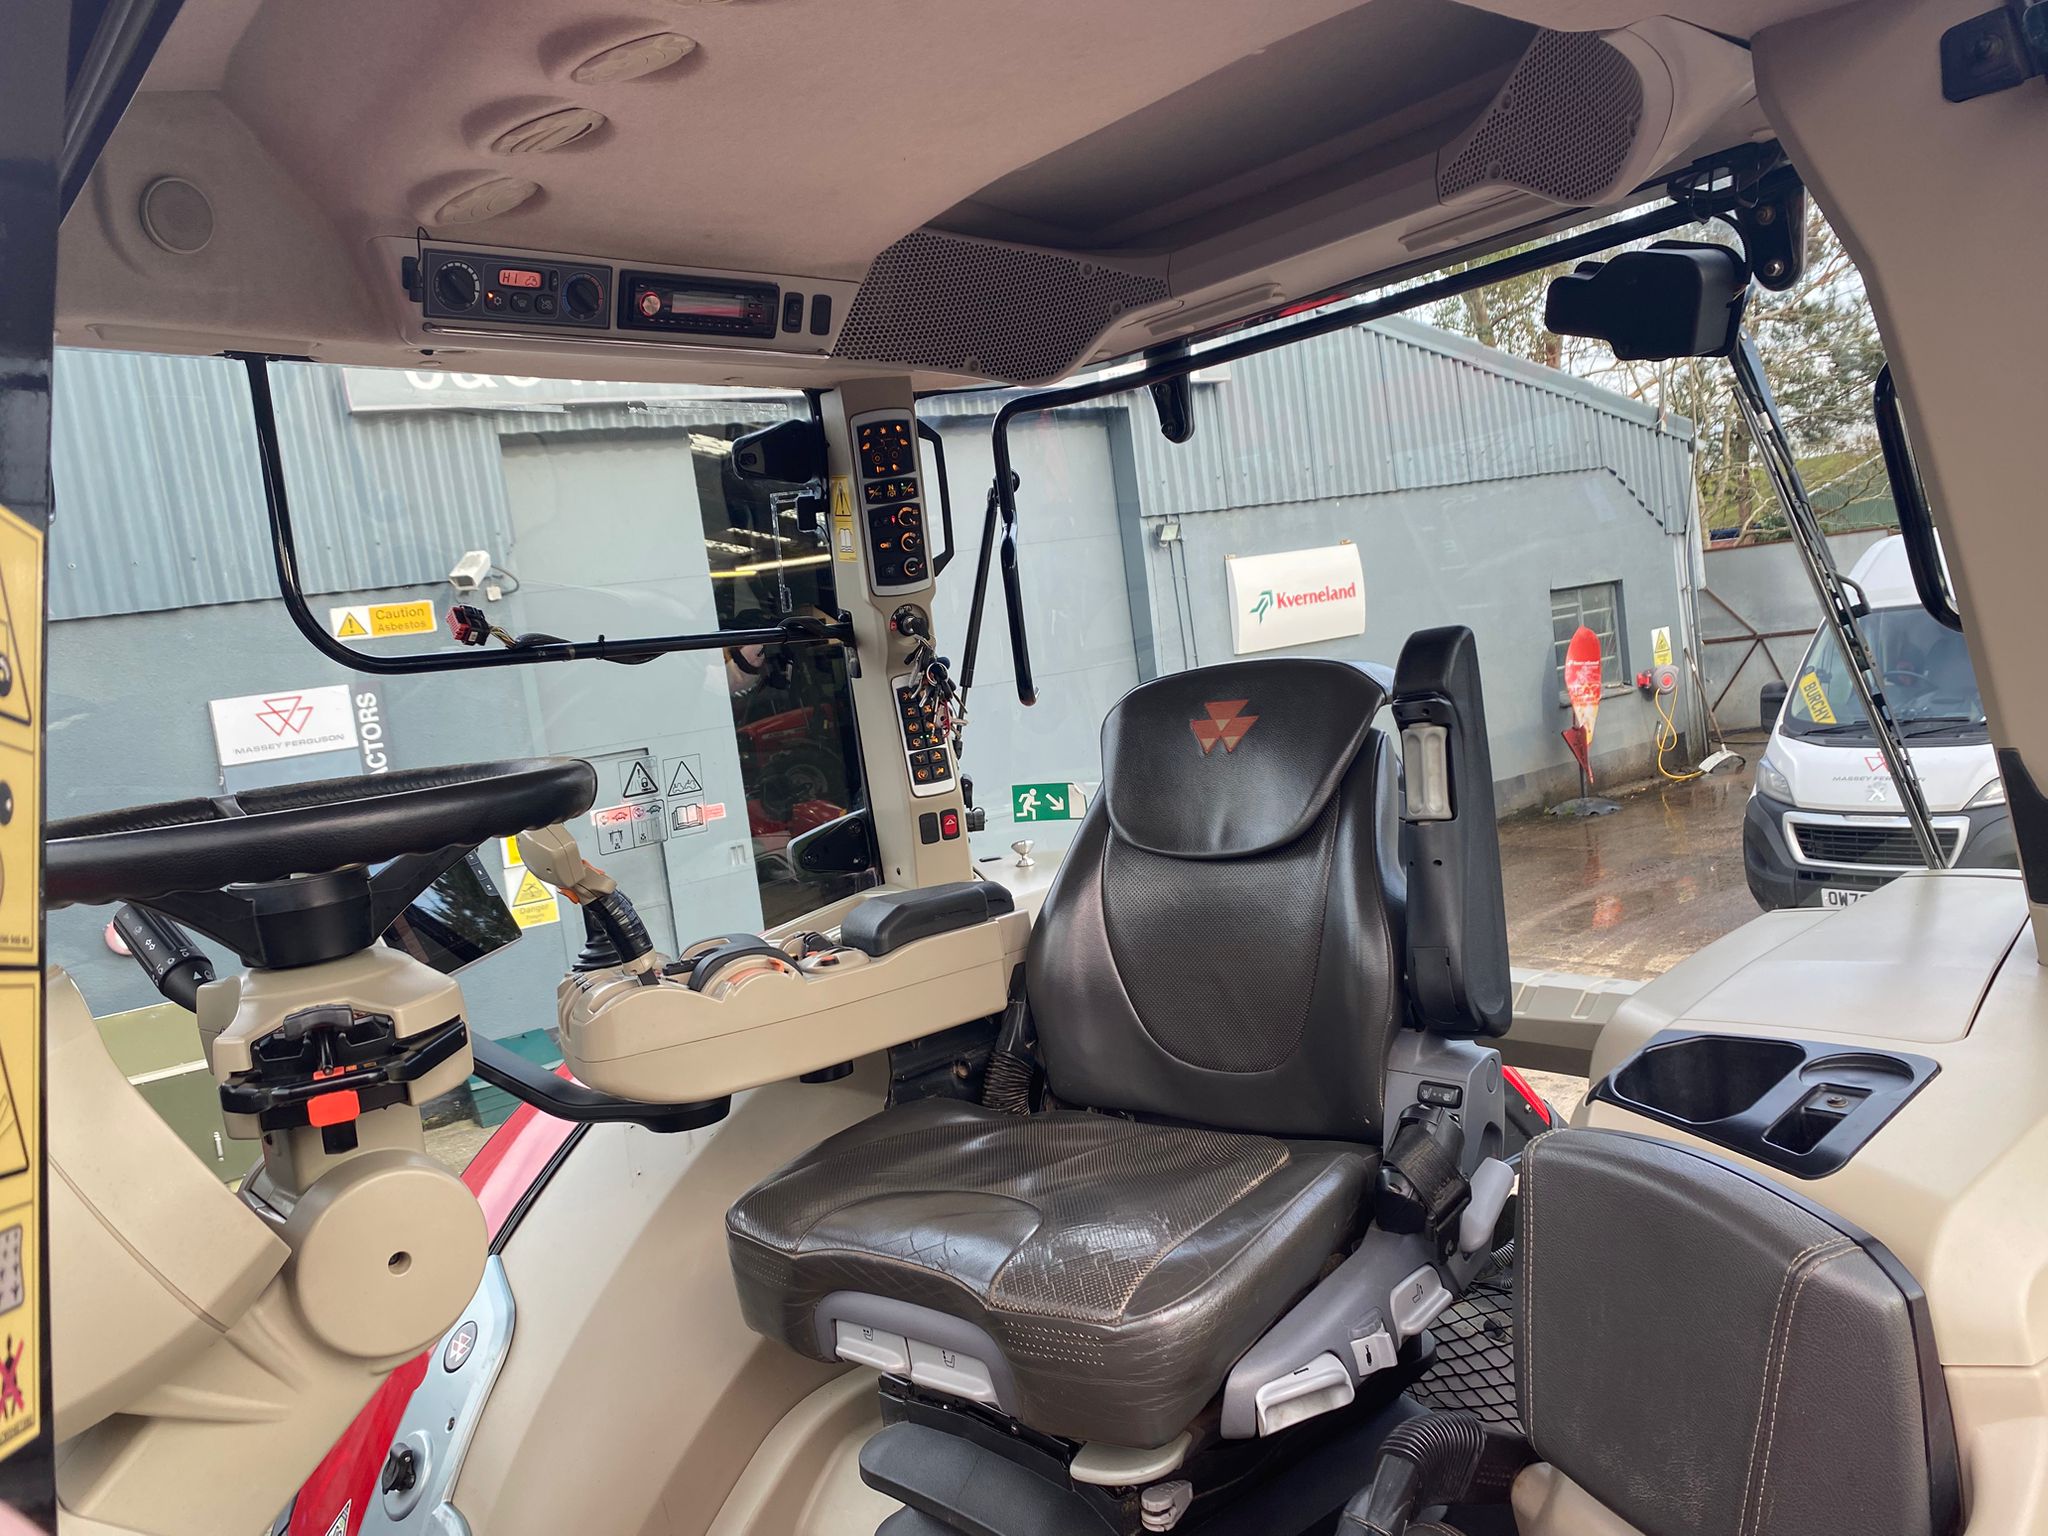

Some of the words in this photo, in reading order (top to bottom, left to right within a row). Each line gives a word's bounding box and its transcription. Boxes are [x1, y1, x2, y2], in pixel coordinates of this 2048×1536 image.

[1276, 582, 1357, 609] Kverneland
[375, 607, 425, 620] Caution
[378, 619, 427, 632] Asbestos
[1804, 681, 1831, 722] BURCHY
[233, 742, 282, 755] MASSEY
[284, 733, 345, 748] FERGUSON
[1828, 891, 1870, 906] OW7
